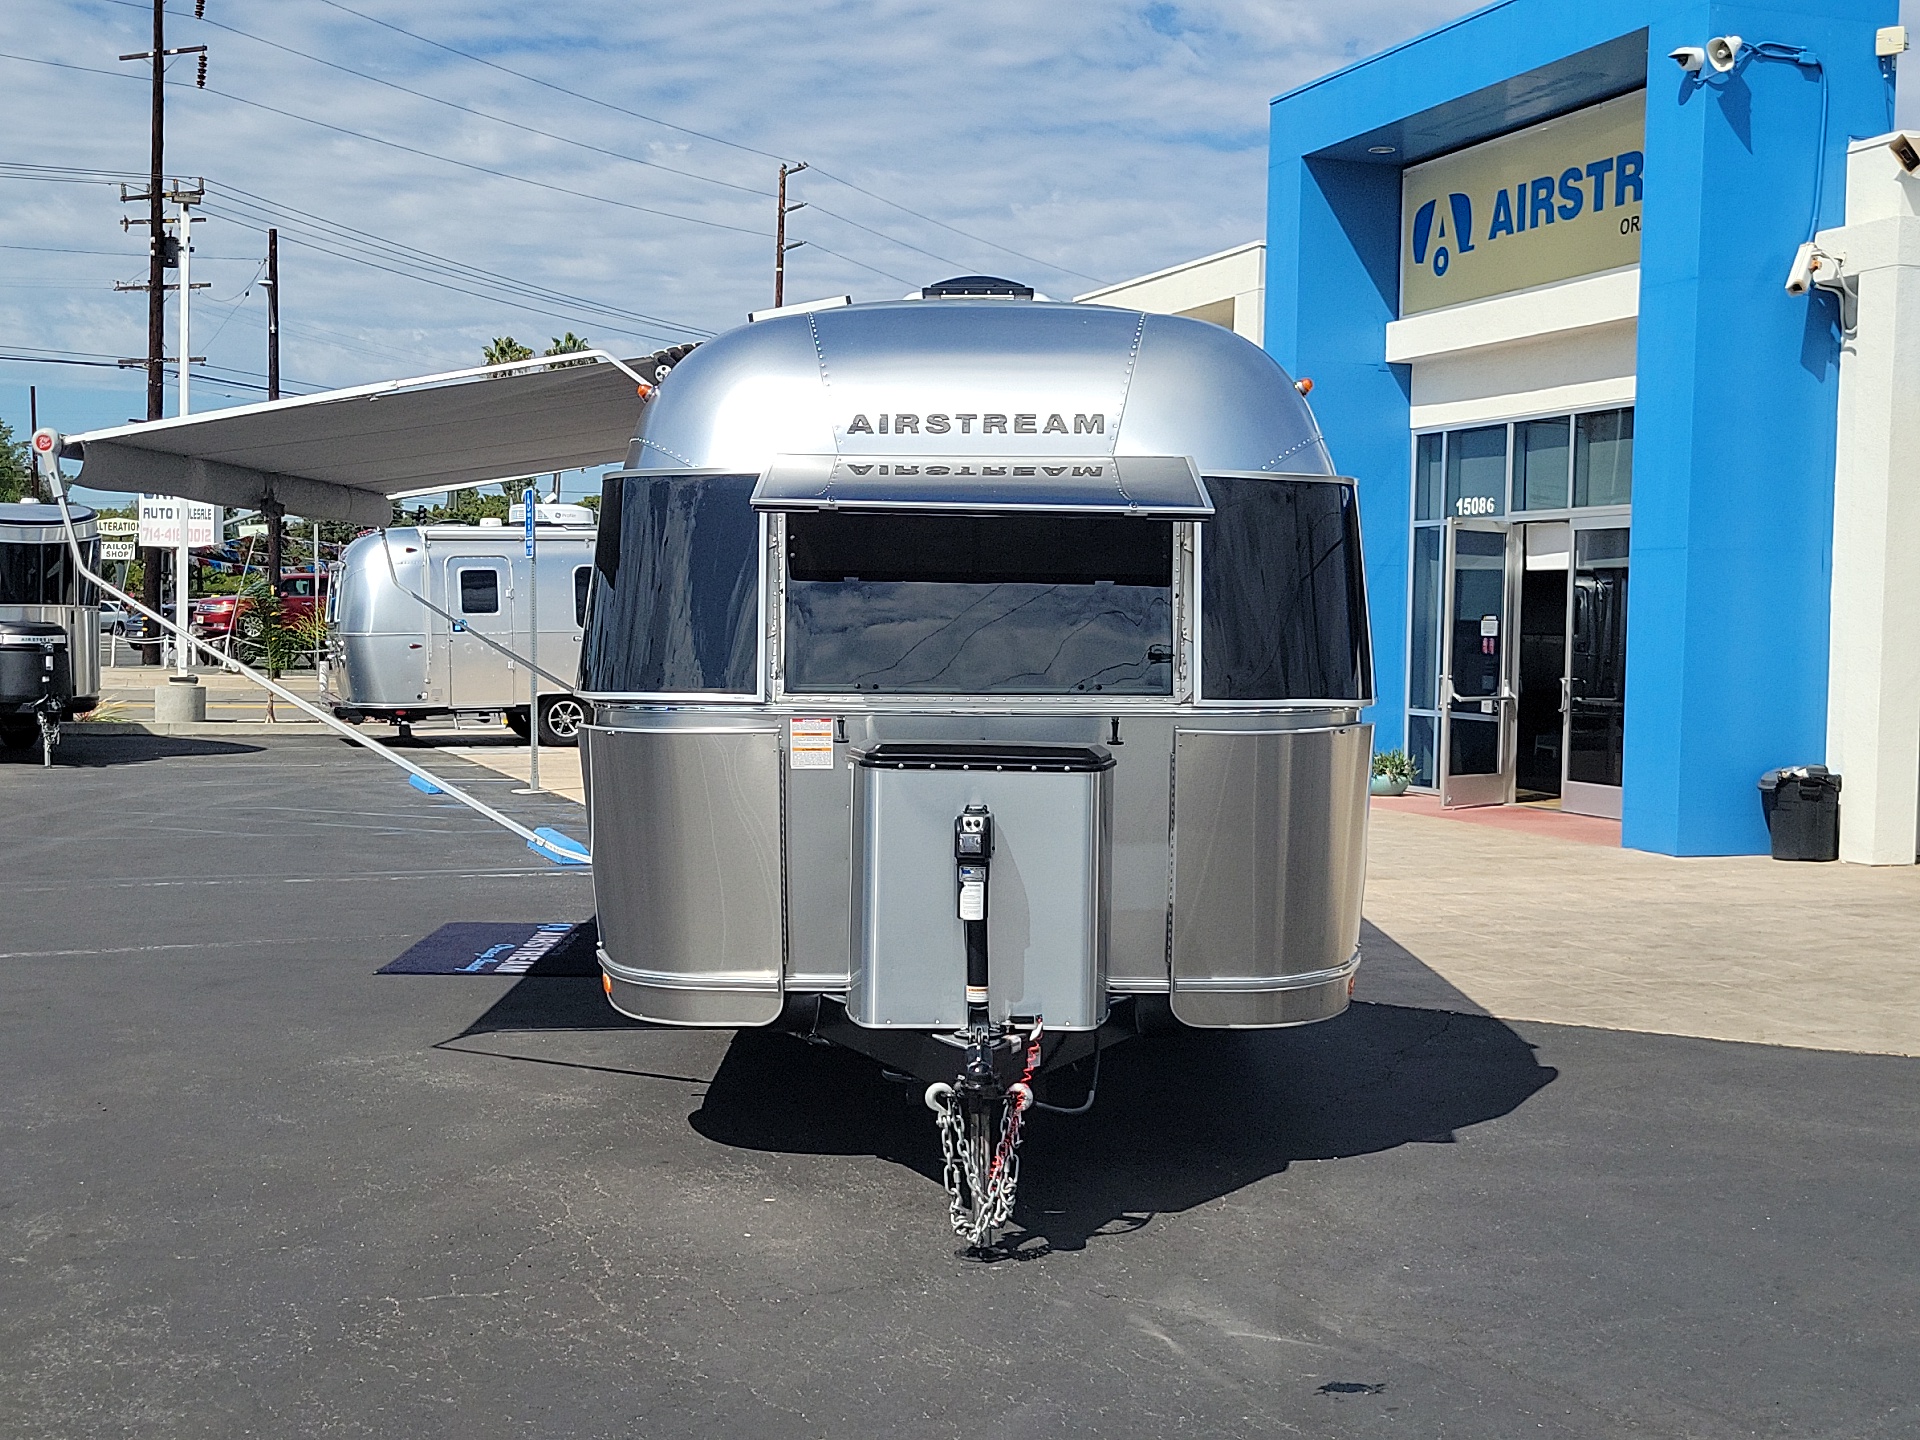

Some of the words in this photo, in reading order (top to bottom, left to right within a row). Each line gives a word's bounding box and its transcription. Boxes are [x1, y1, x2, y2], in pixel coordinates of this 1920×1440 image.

[1487, 150, 1644, 241] AIRSTR
[1620, 215, 1641, 235] OR
[846, 413, 1105, 435] AIRSTREAM
[143, 507, 173, 519] AUTO
[176, 507, 212, 520] LESALE
[1455, 496, 1496, 516] 15086
[96, 521, 139, 531] LTERATIO
[142, 527, 212, 542] 714-4180012
